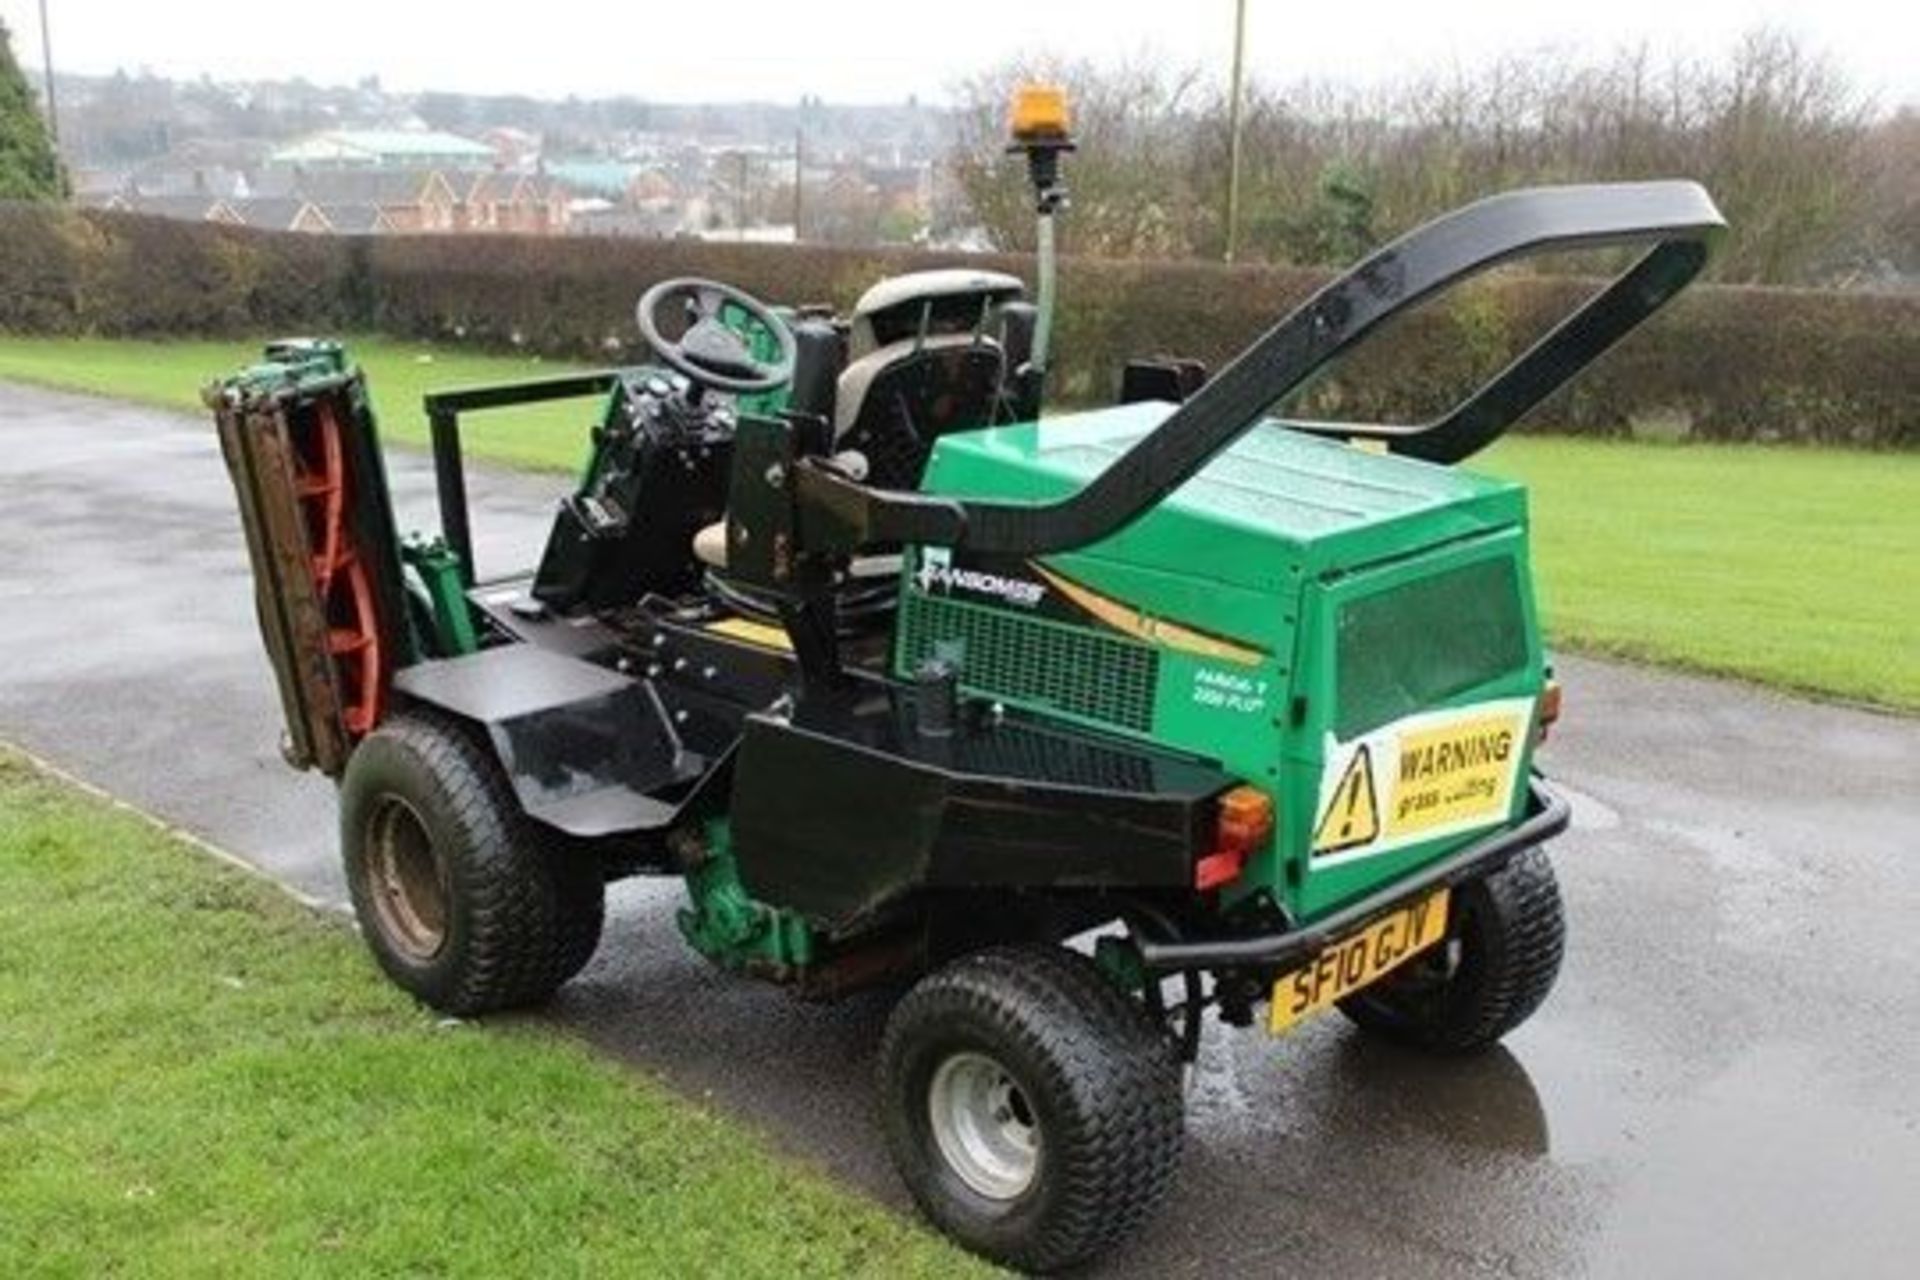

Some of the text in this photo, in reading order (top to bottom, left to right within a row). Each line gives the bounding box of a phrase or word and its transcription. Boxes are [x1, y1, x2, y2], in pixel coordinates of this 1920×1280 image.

[1400, 729, 1511, 781] WARNING
[1398, 789, 1440, 819] grass
[1290, 902, 1430, 1014] SF10 GJV
